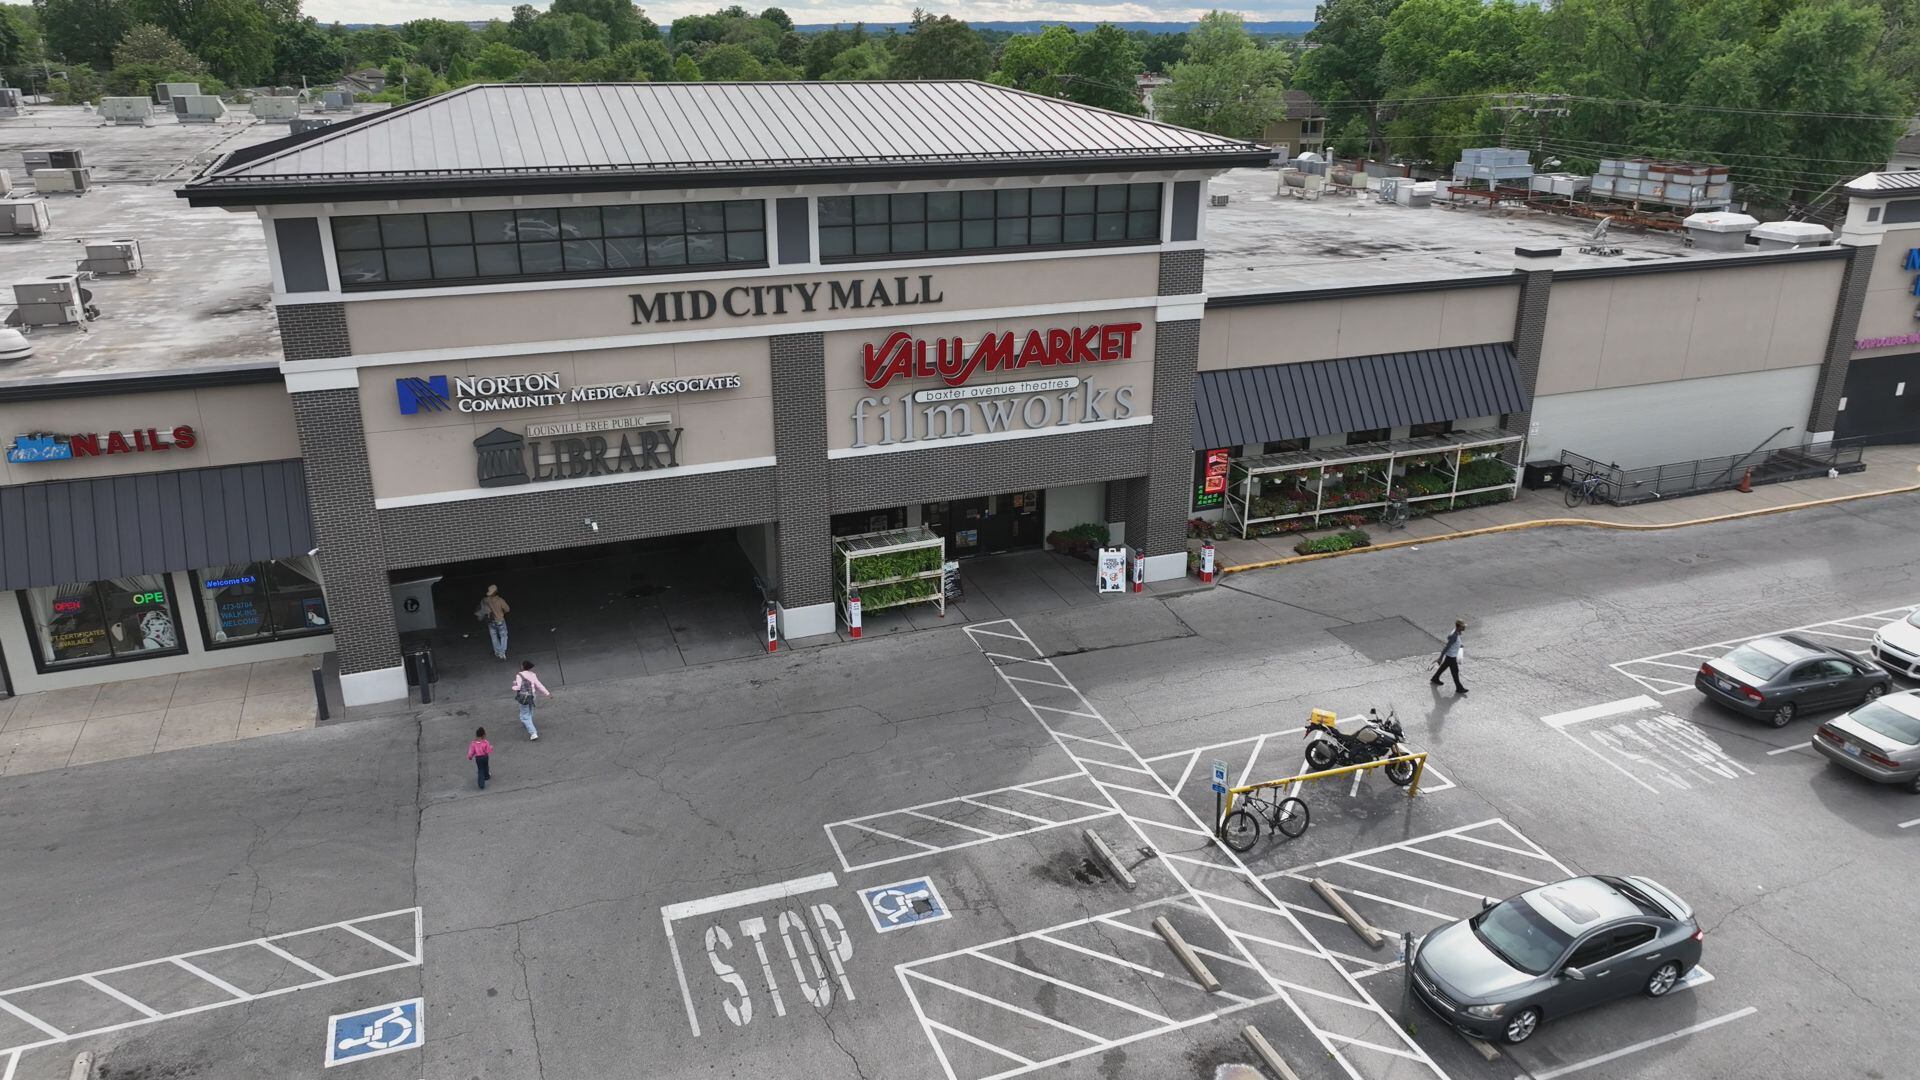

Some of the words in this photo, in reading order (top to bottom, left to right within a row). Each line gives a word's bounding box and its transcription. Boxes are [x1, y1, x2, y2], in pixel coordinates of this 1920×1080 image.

[827, 274, 944, 310] MALL
[454, 373, 561, 399] NORTON
[458, 392, 567, 414] COMMUNITY
[570, 385, 646, 403] MEDICAL
[647, 375, 742, 396] ASSOCIATES
[926, 389, 966, 401] baxter
[970, 384, 1016, 398] avenue
[1020, 379, 1070, 391] theatres
[527, 423, 583, 438] LOUISVILLE
[585, 419, 609, 432] FREE
[612, 415, 645, 429] PUBLIC
[850, 376, 1136, 448] filmworks
[70, 425, 197, 457] NAILS
[528, 427, 684, 483] LIBRARY
[54, 601, 80, 611] OPEN
[705, 903, 855, 1027] STOP
